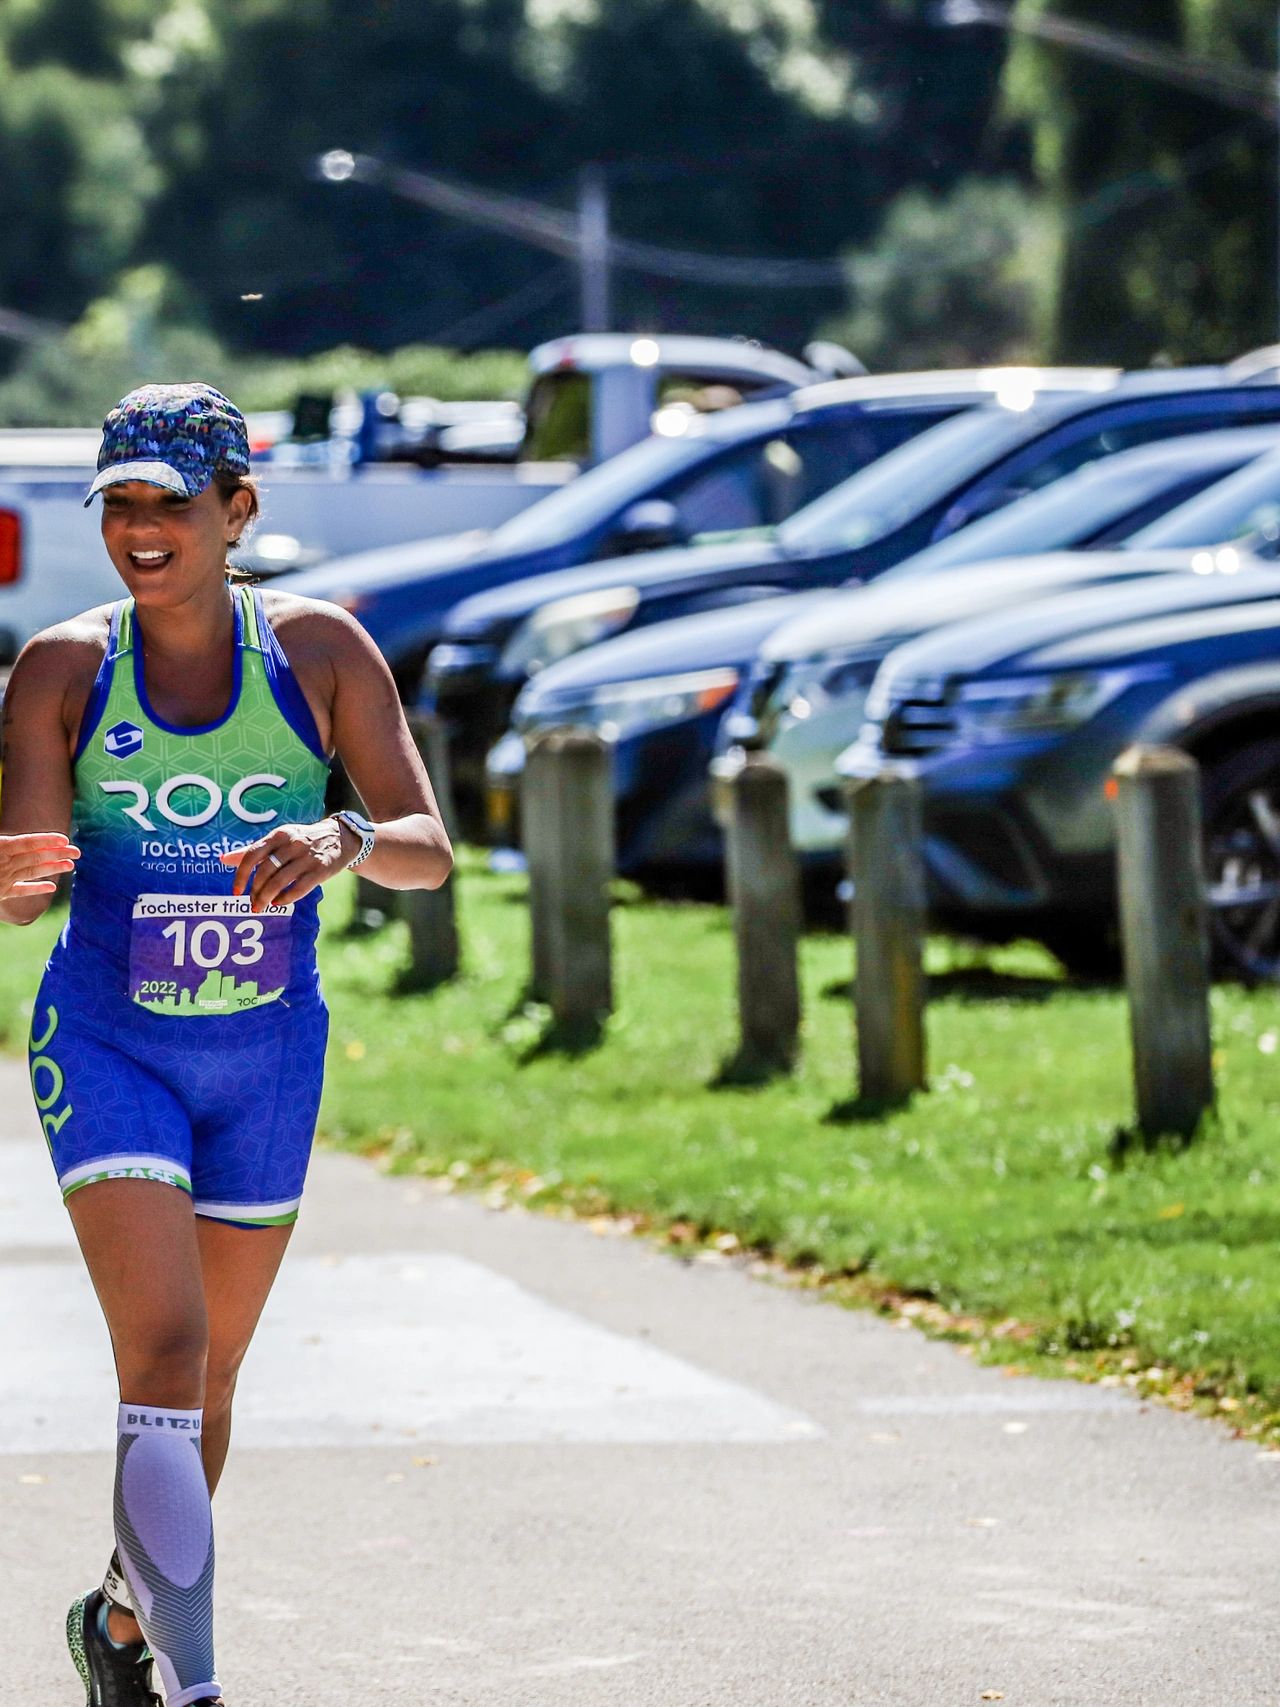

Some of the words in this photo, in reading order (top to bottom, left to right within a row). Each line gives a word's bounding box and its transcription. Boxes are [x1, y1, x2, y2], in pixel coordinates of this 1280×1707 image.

[99, 774, 287, 832] ROC
[141, 861, 177, 873] area
[141, 900, 218, 915] rochester
[223, 899, 288, 914] trialon
[162, 919, 265, 968] 103
[140, 981, 178, 994] 2022
[237, 997, 258, 1007] ROC
[127, 1414, 200, 1430] BLITZU
